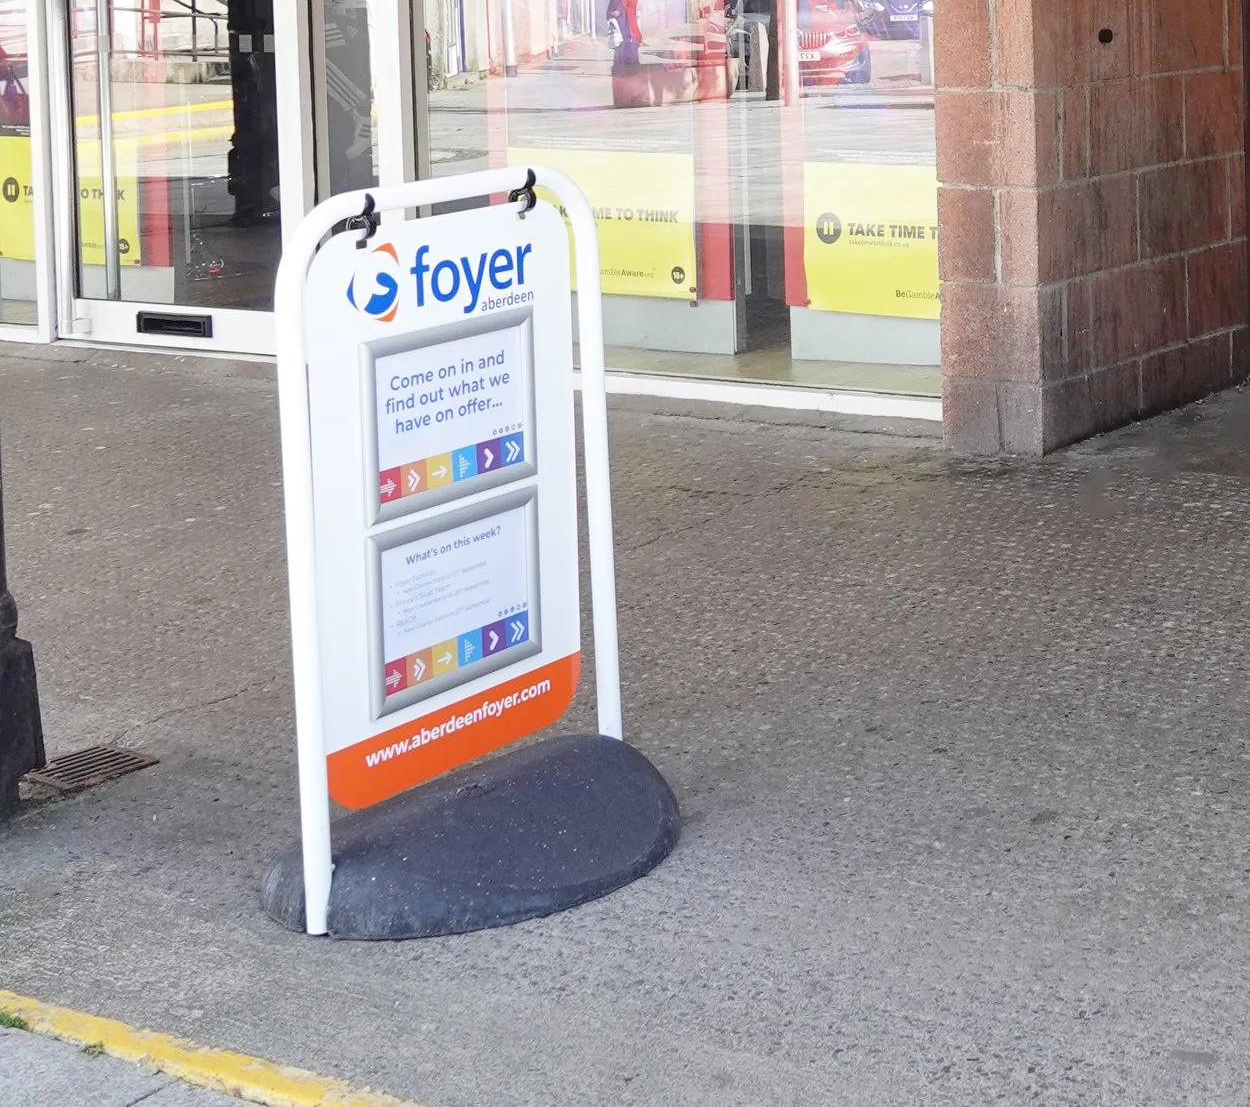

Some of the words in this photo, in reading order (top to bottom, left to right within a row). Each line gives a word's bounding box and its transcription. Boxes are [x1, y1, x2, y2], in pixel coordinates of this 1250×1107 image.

[616, 208, 634, 220] TO
[637, 209, 678, 223] THINK
[847, 223, 885, 237] TAKE
[889, 225, 925, 239] TIME
[410, 243, 532, 313] foyer
[895, 289, 940, 300] BeGambleA
[481, 290, 534, 312] aberdeen
[390, 369, 433, 391] Come
[438, 366, 456, 380] on
[460, 358, 474, 372] in
[478, 350, 505, 370] and
[385, 392, 415, 415] find
[419, 389, 443, 405] out
[448, 375, 485, 398] what
[489, 371, 510, 386] we
[395, 412, 431, 435] have
[435, 408, 454, 422] on
[458, 396, 503, 417] offer...
[406, 548, 438, 564] What's
[440, 544, 452, 554] on
[453, 536, 471, 549] this
[473, 527, 501, 542] week?
[365, 678, 551, 768] www.aberdeenfoyer.com
